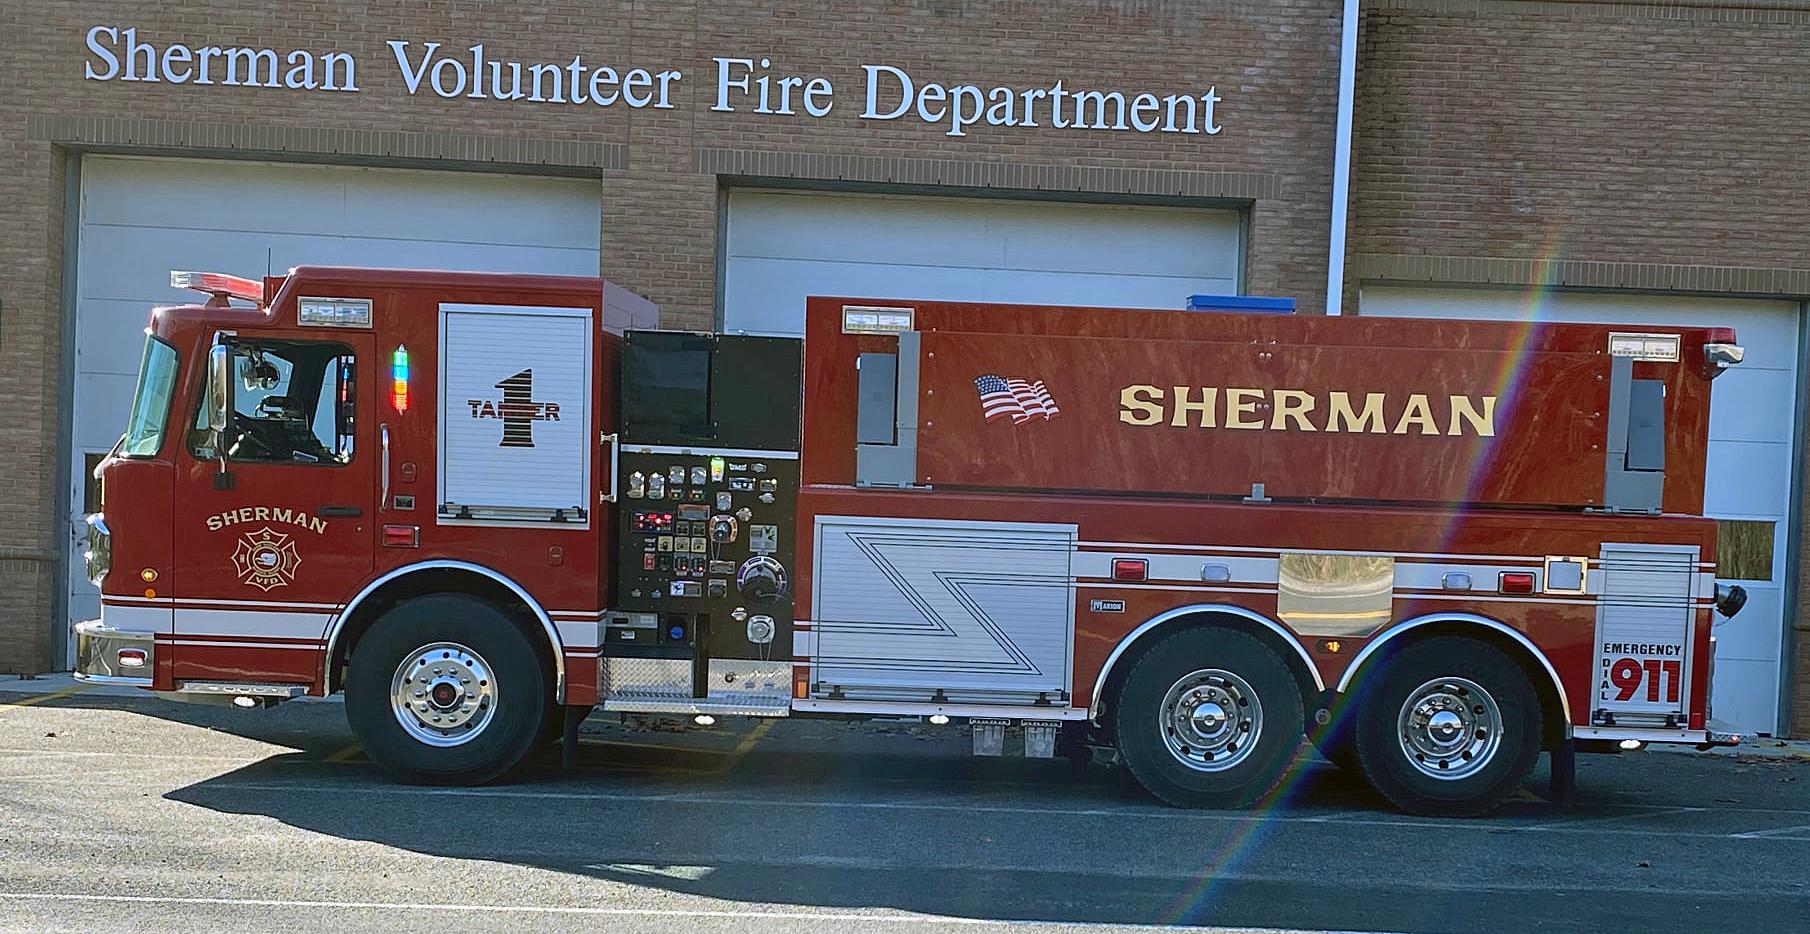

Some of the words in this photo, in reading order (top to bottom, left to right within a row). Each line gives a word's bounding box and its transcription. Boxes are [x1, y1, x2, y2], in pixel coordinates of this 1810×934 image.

[85, 25, 359, 92] Sherman
[386, 40, 682, 109] Volunteer
[710, 56, 833, 117] Fire
[859, 64, 1222, 136] Department
[467, 399, 561, 421] TAER
[1119, 384, 1497, 437] SHERMAN
[206, 507, 328, 534] SHERMAN
[255, 576, 279, 585] VFD
[1603, 643, 1682, 655] EMERGENCY
[1601, 658, 1611, 700] DIAL
[1611, 657, 1681, 703] 911
